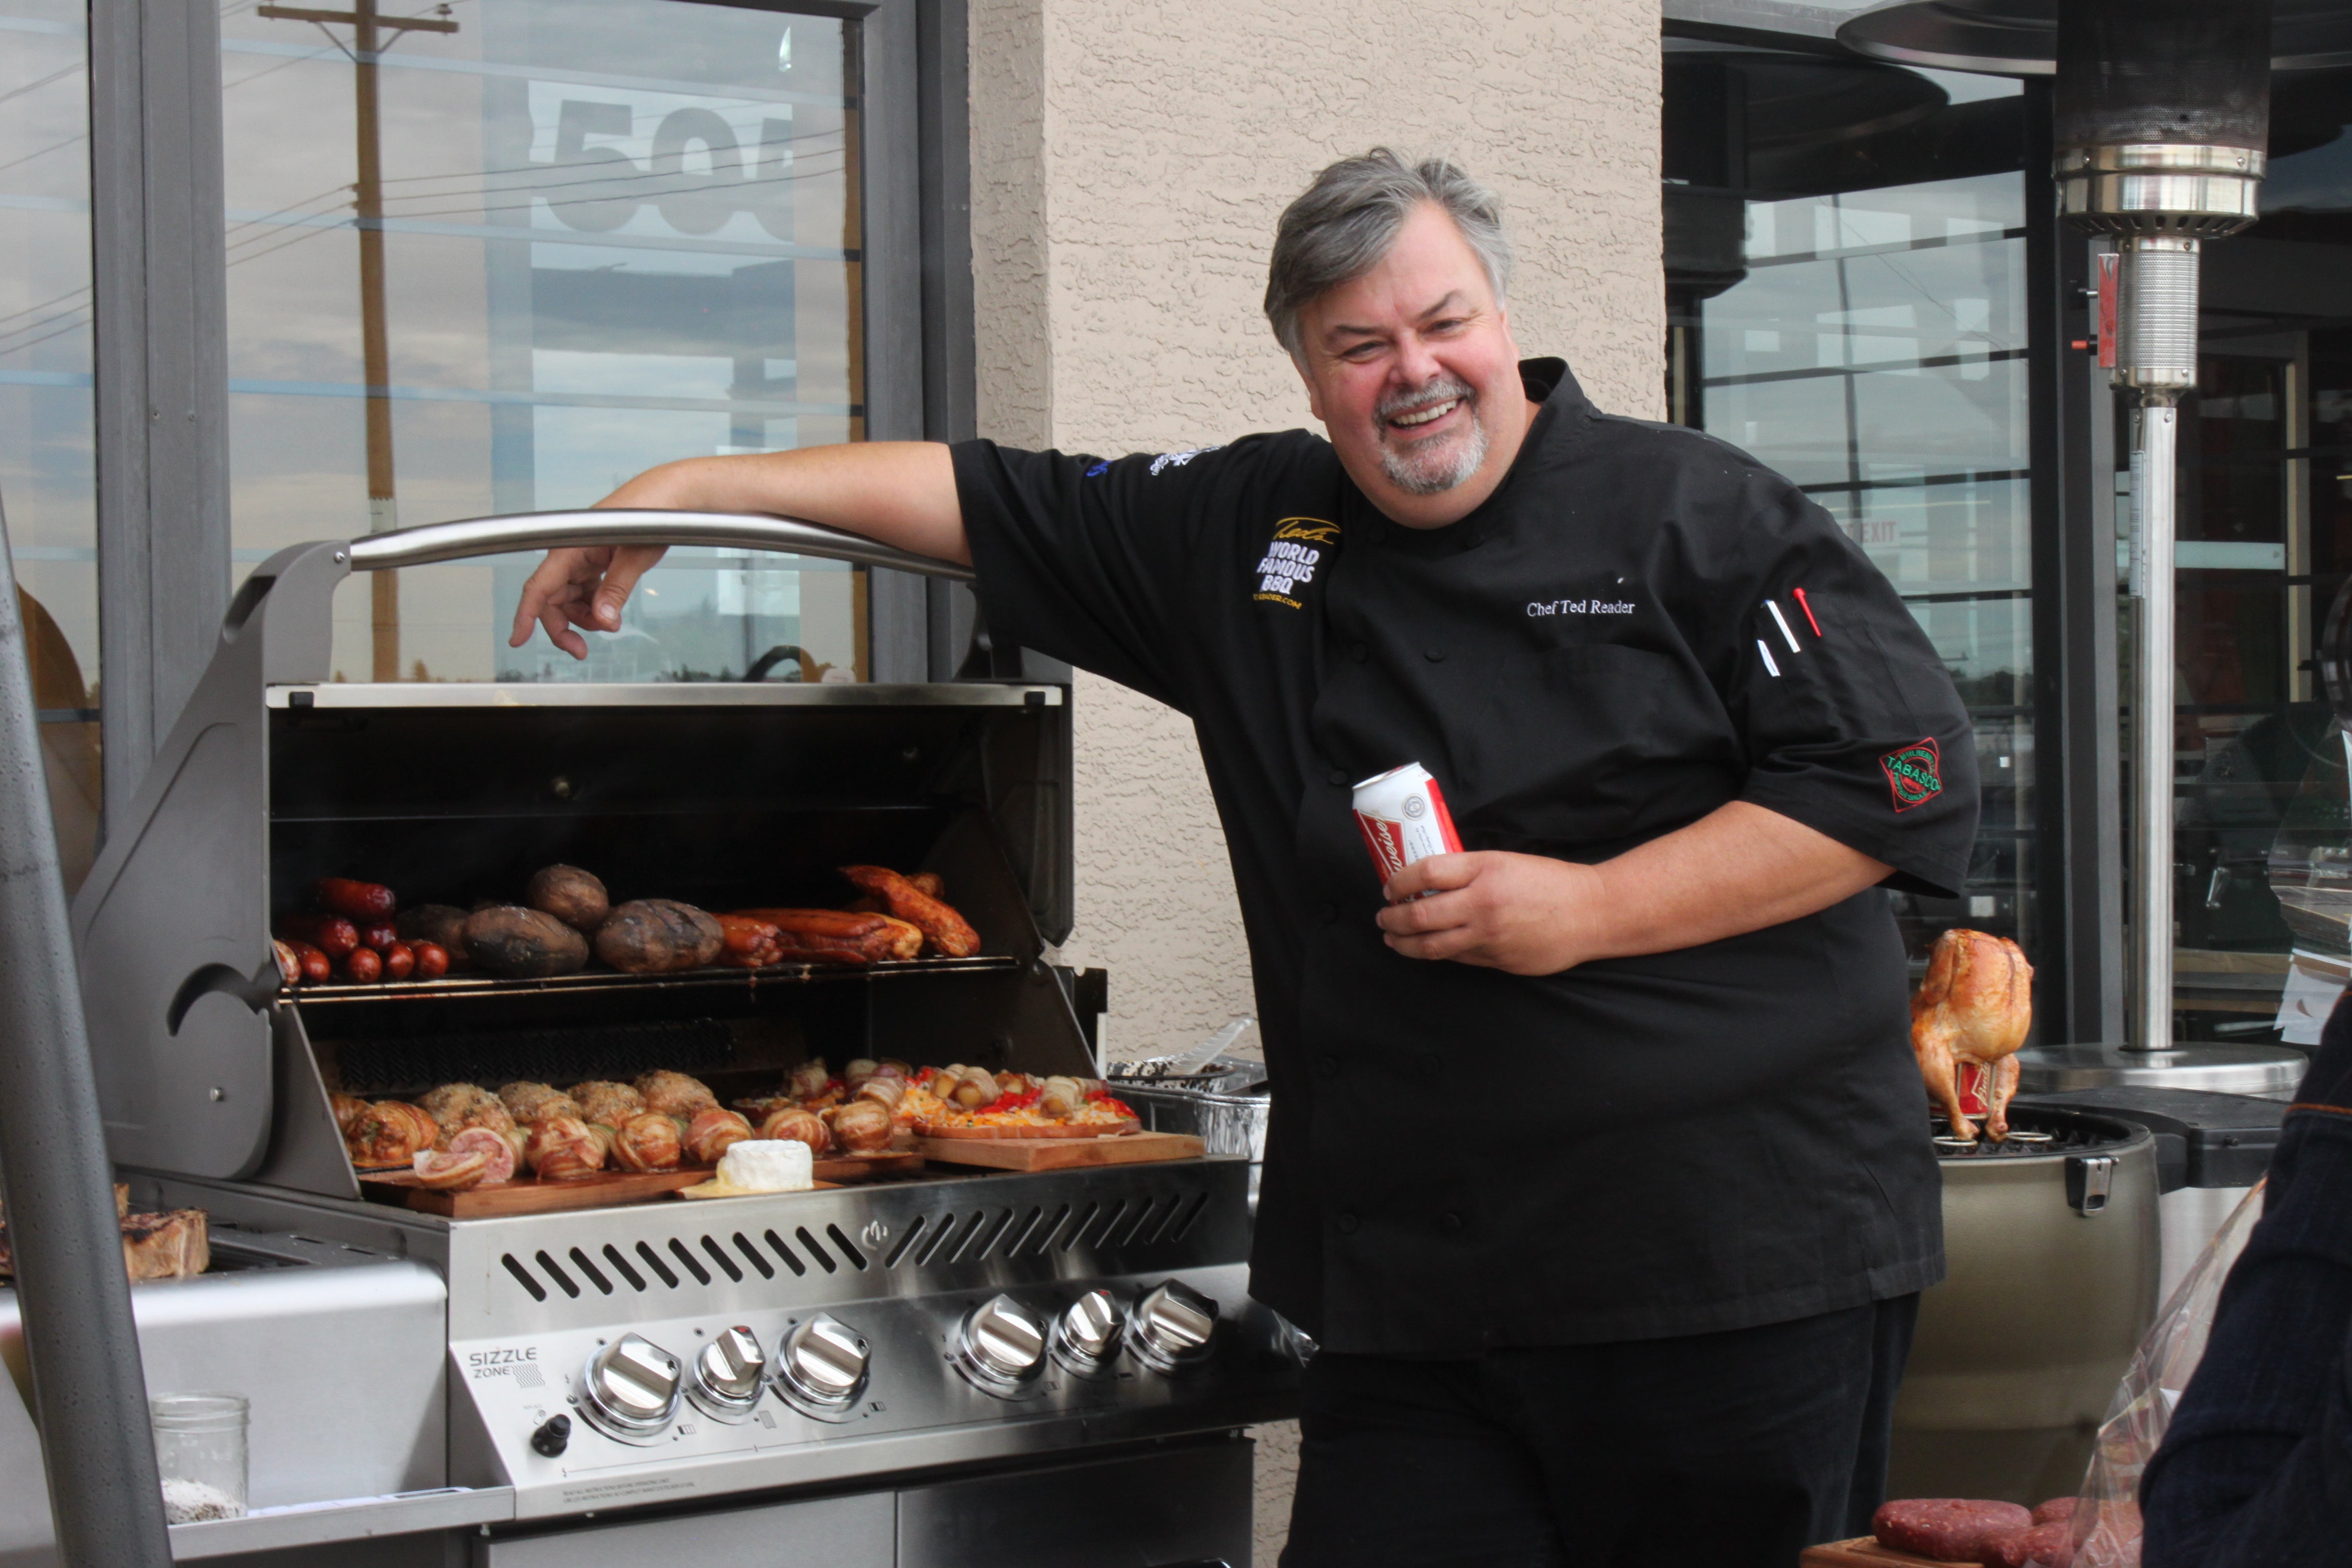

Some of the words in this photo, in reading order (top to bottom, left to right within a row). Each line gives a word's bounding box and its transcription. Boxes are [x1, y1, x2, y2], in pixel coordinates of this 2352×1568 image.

[1860, 521, 1897, 543] EXIT
[1268, 541, 1320, 565] WORLD
[1256, 557, 1315, 583] FAMOUS
[1260, 575, 1294, 595] BBQ
[1527, 601, 1559, 617] Chef
[1561, 599, 1586, 614] Ted
[1590, 599, 1636, 614] Reader
[1887, 755, 1939, 791] TABASCO
[470, 1347, 537, 1367] SIZZLE
[474, 1366, 511, 1379] ZONE
